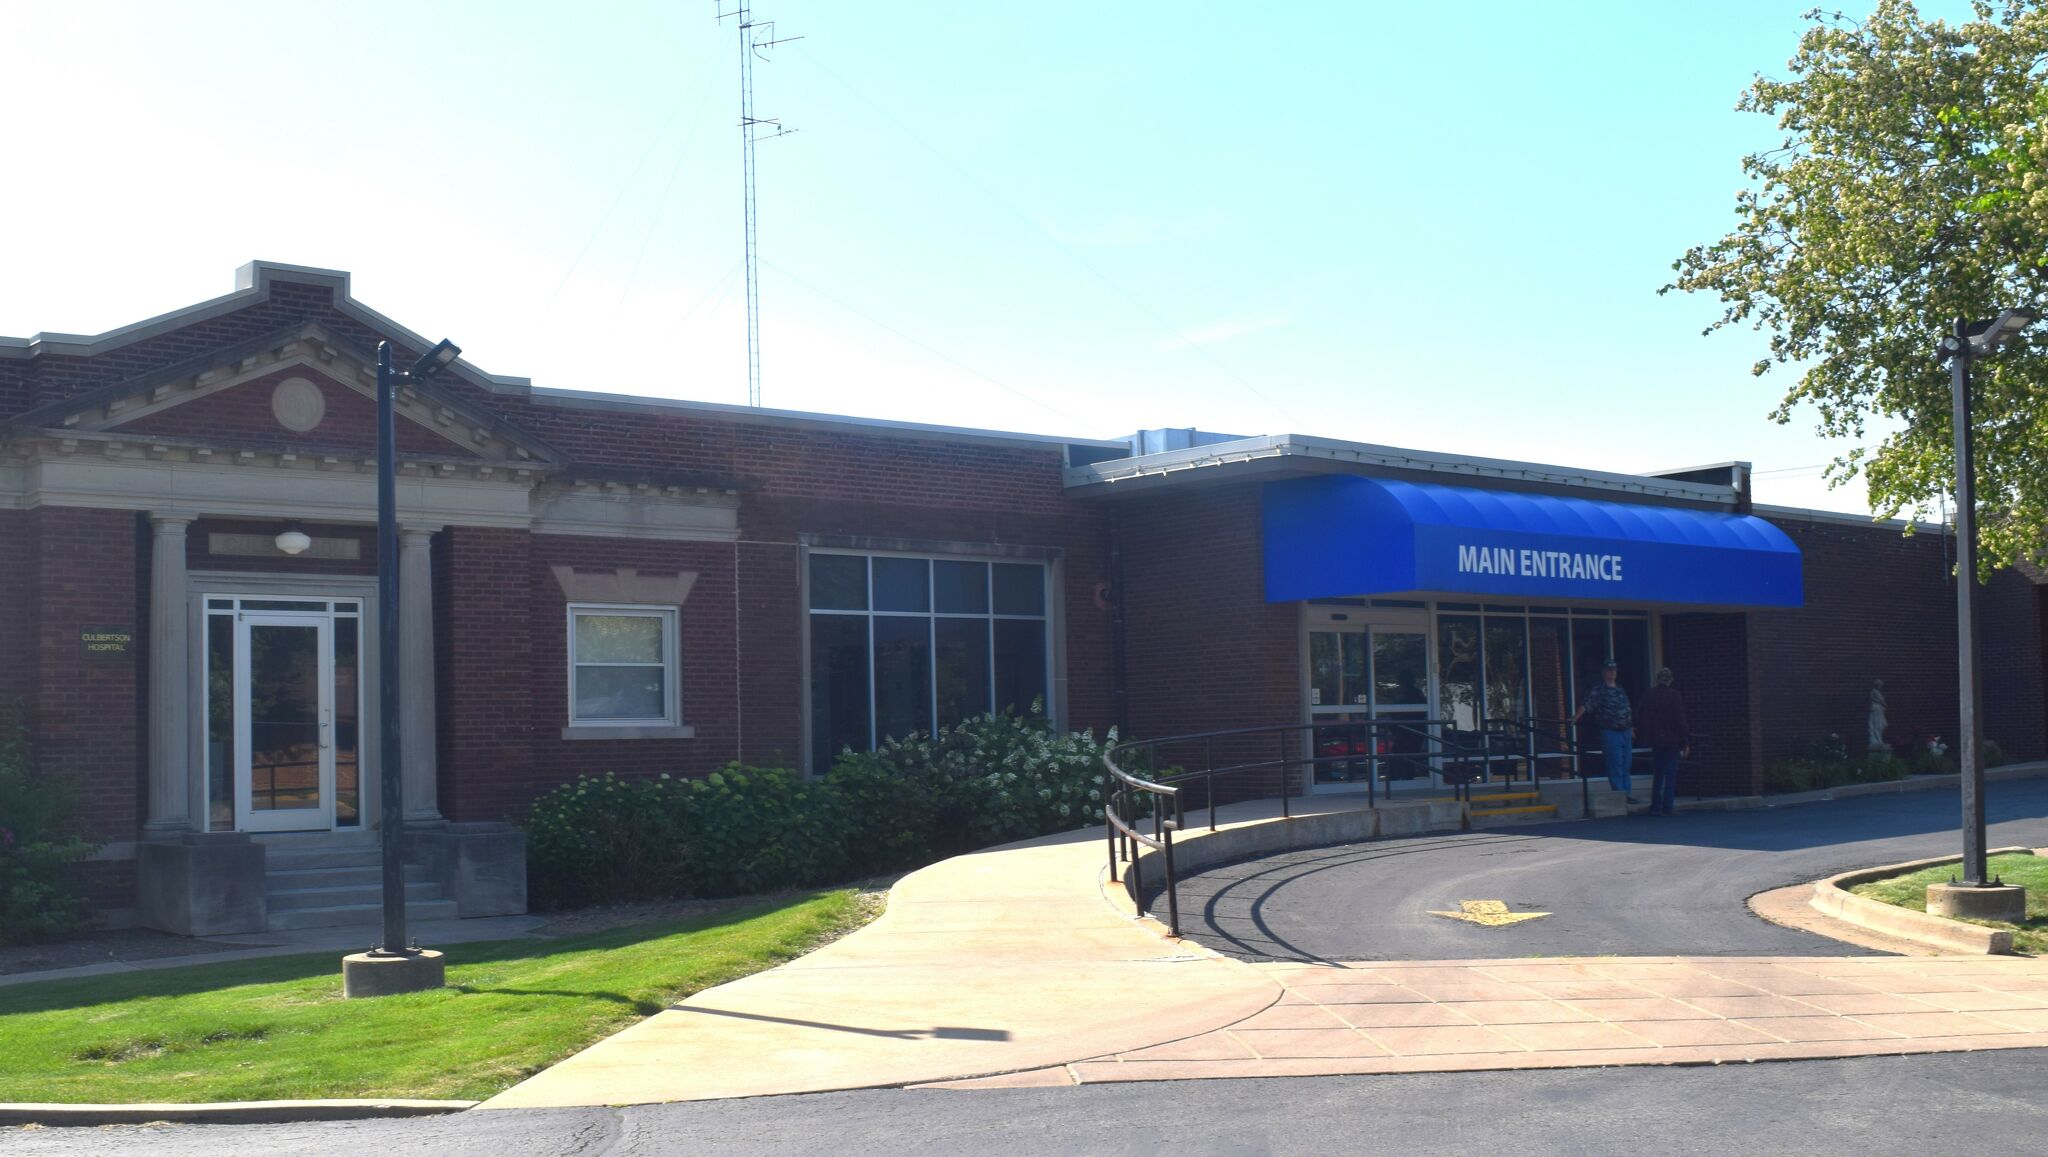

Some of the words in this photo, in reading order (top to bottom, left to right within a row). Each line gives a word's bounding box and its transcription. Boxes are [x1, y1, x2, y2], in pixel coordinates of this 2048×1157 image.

[1458, 545, 1515, 576] MAIN
[1520, 549, 1622, 581] ENTRANCE
[82, 633, 131, 641] CULBERTSON
[87, 643, 126, 651] HOSPITAL
